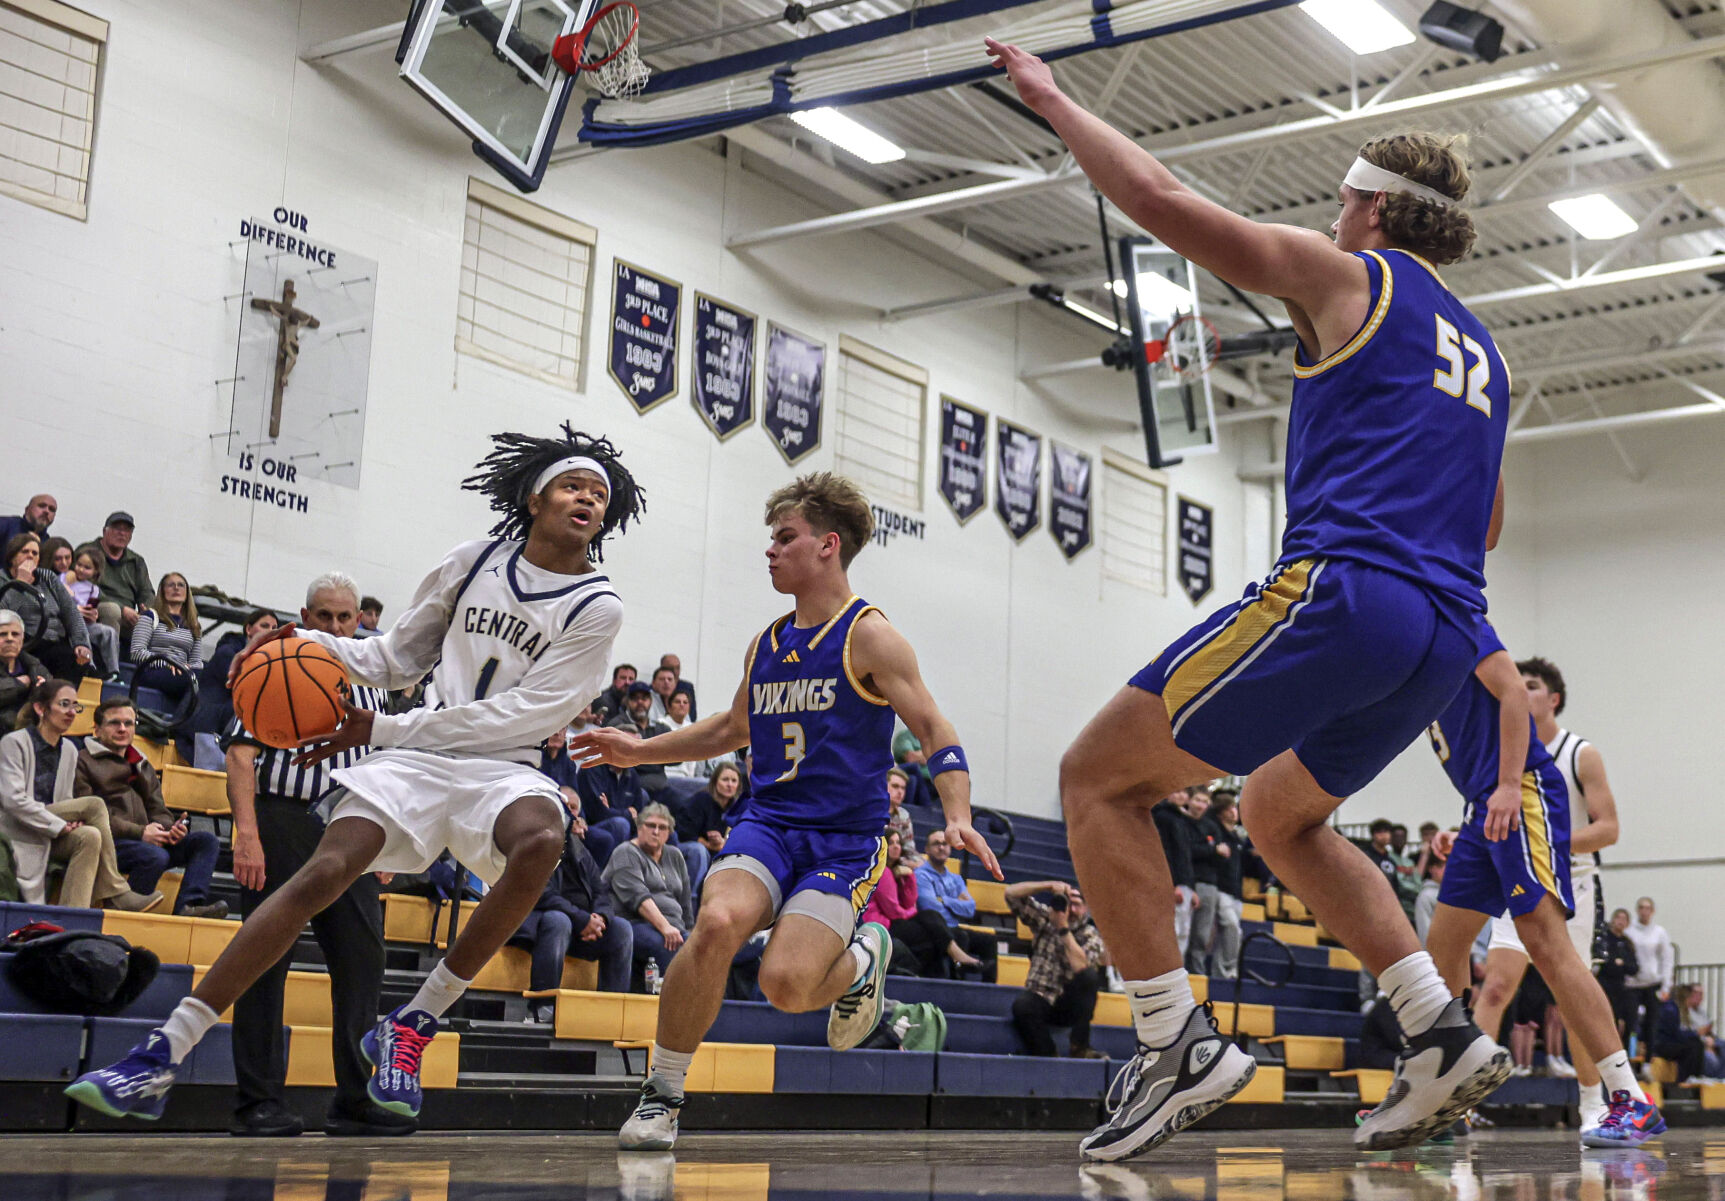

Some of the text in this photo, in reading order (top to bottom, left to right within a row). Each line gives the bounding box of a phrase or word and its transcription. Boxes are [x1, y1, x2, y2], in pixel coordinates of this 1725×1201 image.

[273, 206, 308, 233] OUR
[240, 219, 336, 268] DIFFERENCE
[615, 315, 635, 336] GIRLS
[625, 293, 669, 325] 3RD PLACE
[1433, 312, 1491, 419] 52
[239, 451, 297, 483] IS OUR
[220, 474, 309, 513] STRENGTH
[871, 504, 926, 540] STUDENT
[473, 656, 500, 701] 1
[752, 677, 838, 715] VIKINGS
[774, 721, 807, 783] 3
